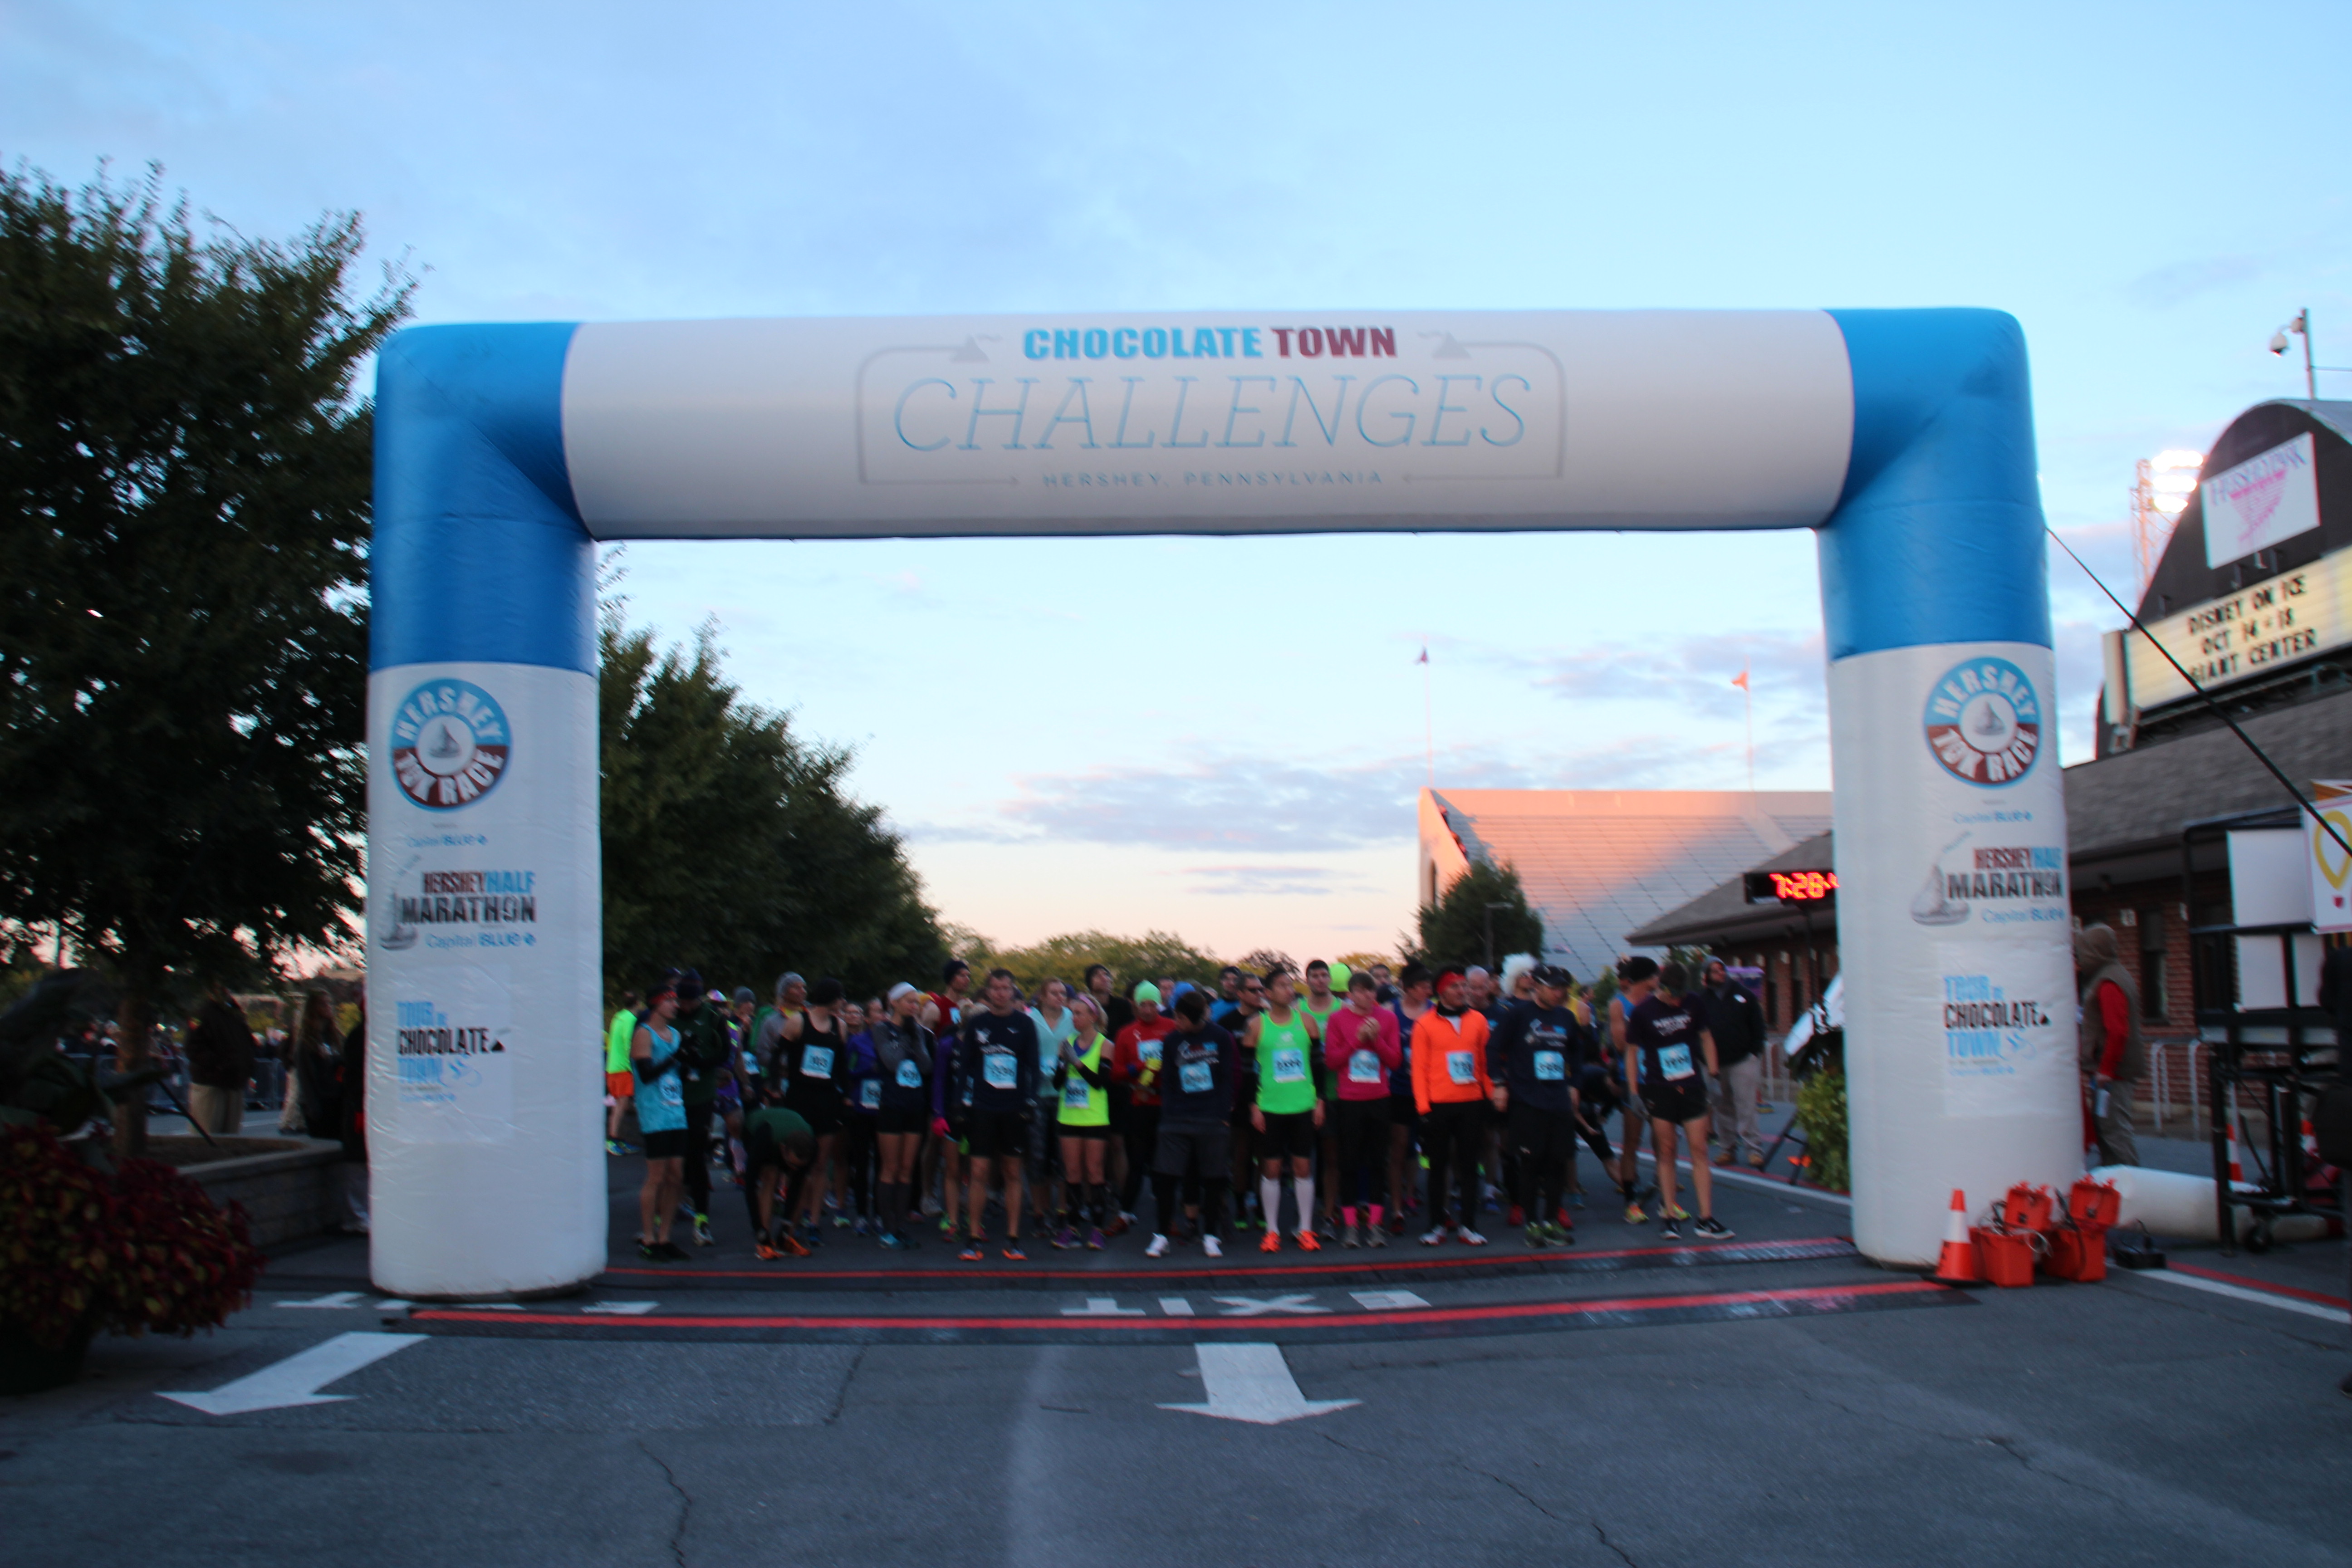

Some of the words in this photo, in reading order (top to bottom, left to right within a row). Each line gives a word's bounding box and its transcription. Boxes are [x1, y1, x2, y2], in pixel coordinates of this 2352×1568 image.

[1024, 327, 1264, 359] CHOCOLATE
[1269, 326, 1397, 358] TOWN
[893, 373, 1531, 451] CHALLENGES
[1182, 470, 1383, 487] PENNSYLVANIA
[2251, 586, 2274, 610] ON
[2201, 631, 2230, 656] OCT
[2249, 628, 2317, 665] CENTER
[1933, 664, 2036, 719] HERSHEY
[395, 686, 504, 742] HERSHEY
[402, 895, 537, 923] MARATHON
